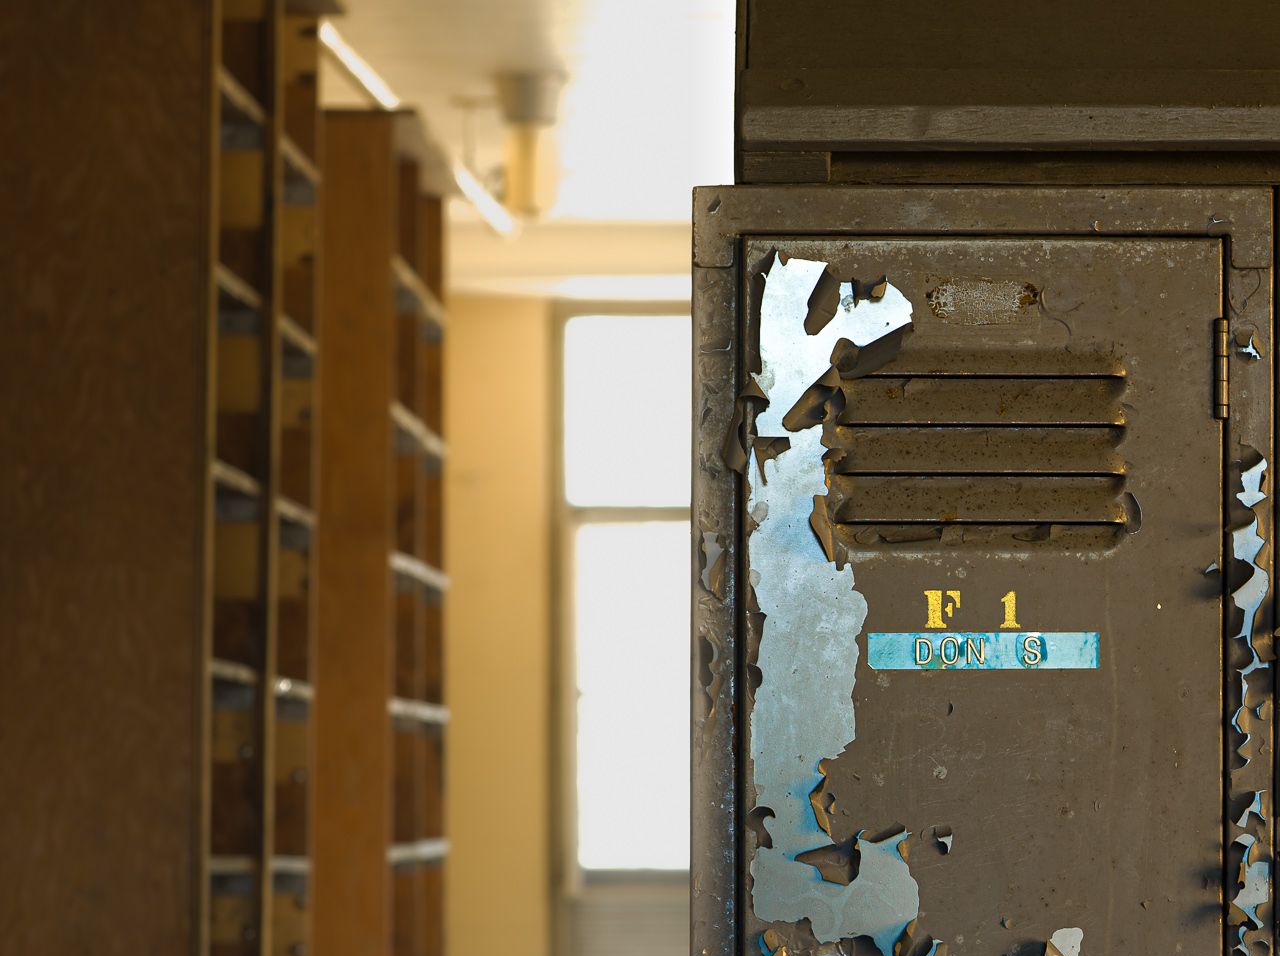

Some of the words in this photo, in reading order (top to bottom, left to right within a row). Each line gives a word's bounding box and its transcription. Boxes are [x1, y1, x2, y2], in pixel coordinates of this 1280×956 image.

[923, 589, 961, 629] F
[999, 590, 1022, 629] 1
[913, 636, 986, 666] DON
[1022, 635, 1043, 666] S
